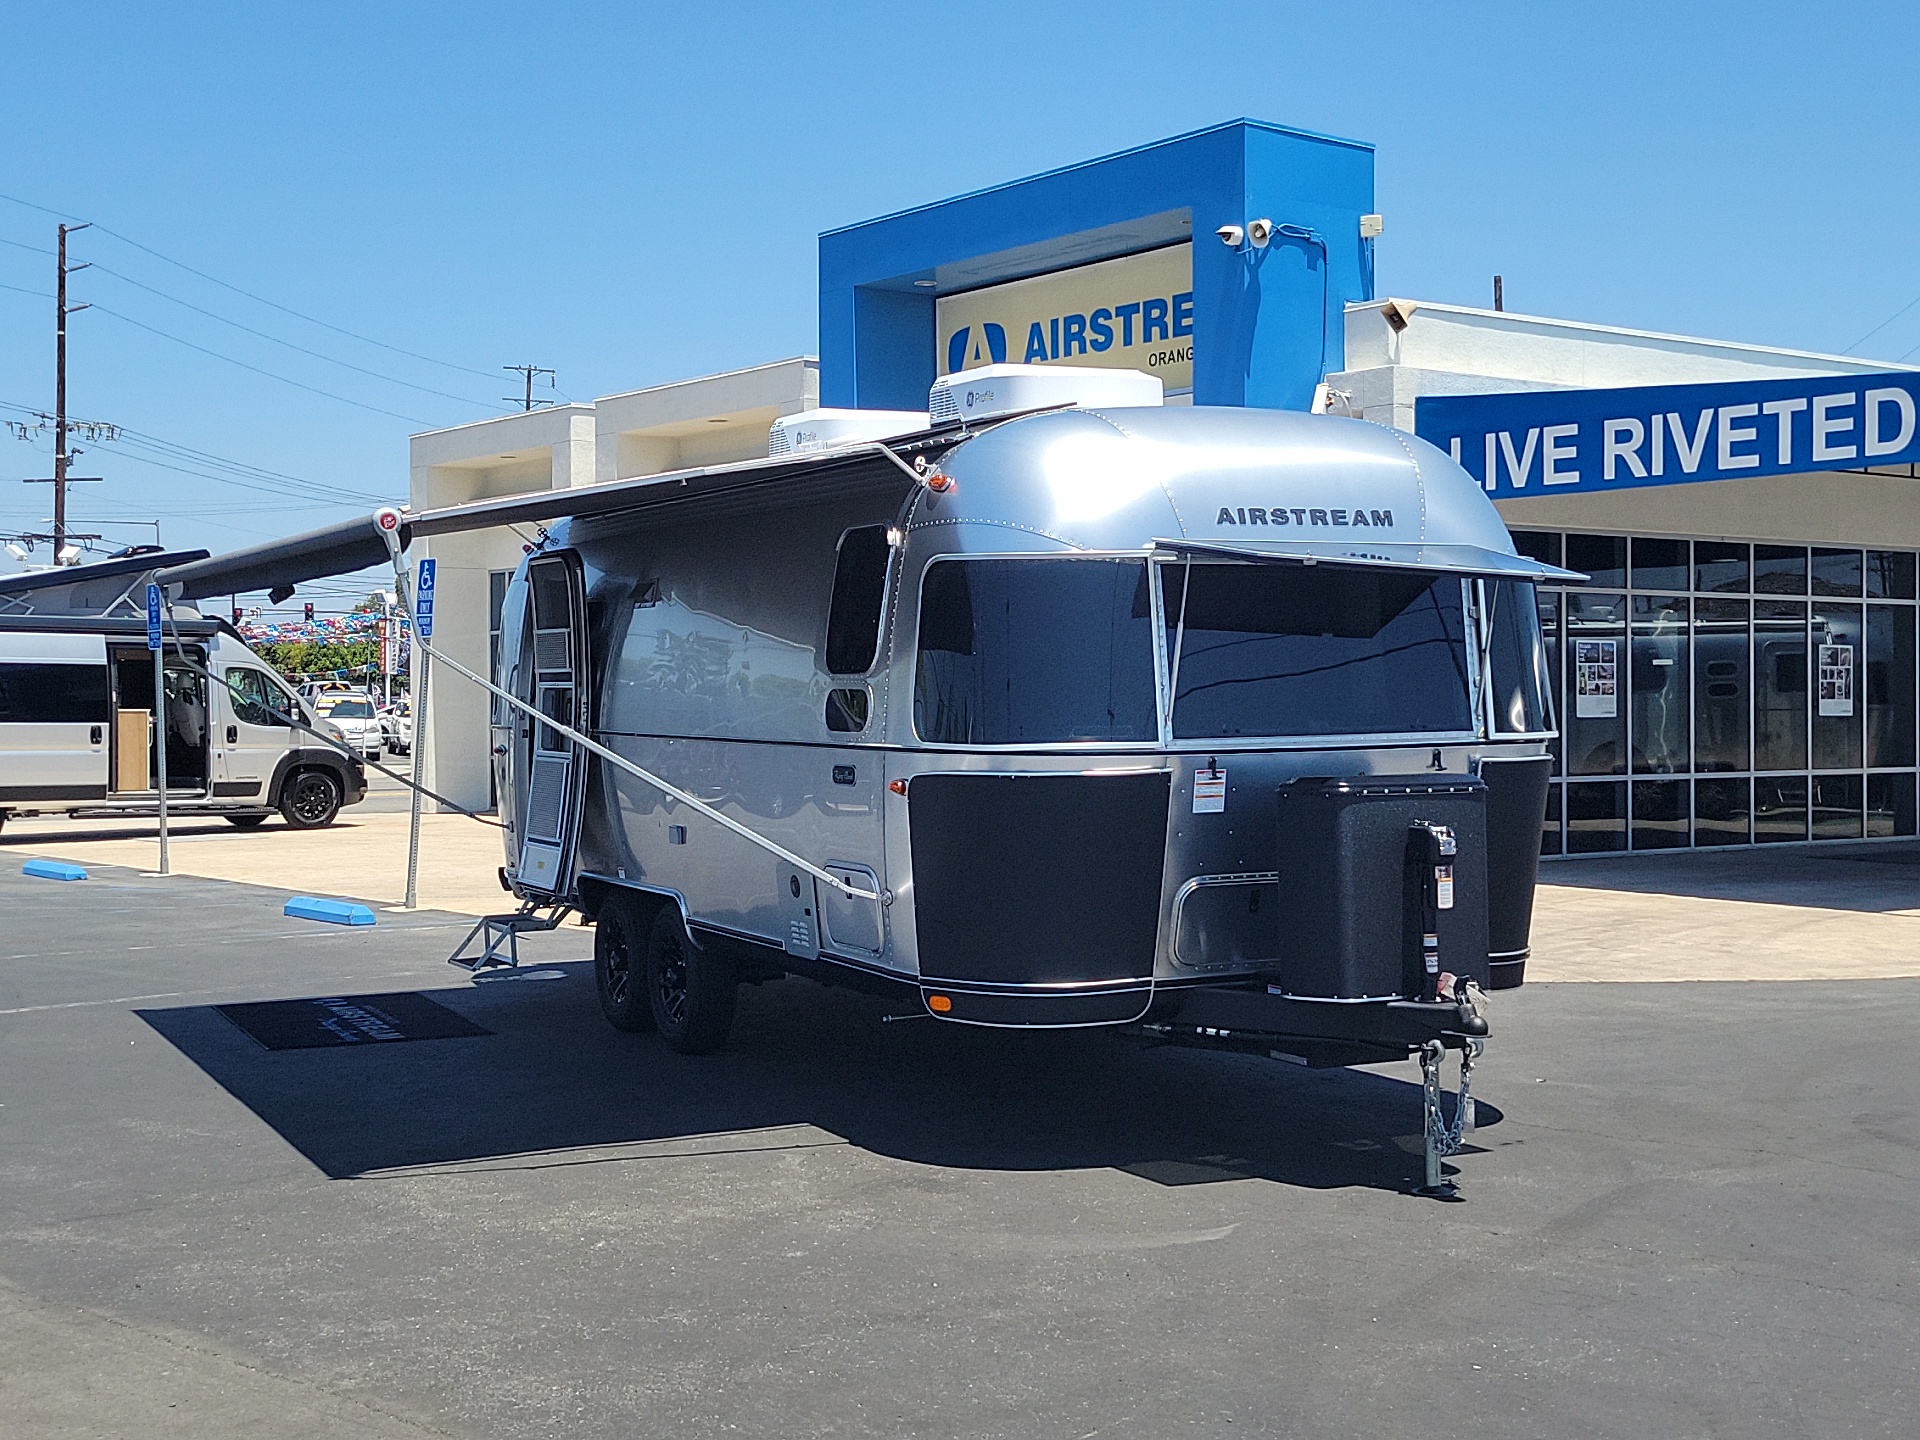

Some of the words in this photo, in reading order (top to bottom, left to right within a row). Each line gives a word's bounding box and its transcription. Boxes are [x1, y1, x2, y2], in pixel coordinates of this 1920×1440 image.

[1024, 291, 1193, 364] AIRSTRE
[1148, 346, 1194, 367] ORANG
[974, 389, 995, 404] Profile
[1603, 386, 1918, 480] RIVETED
[1216, 507, 1395, 527] AIRSTREAM
